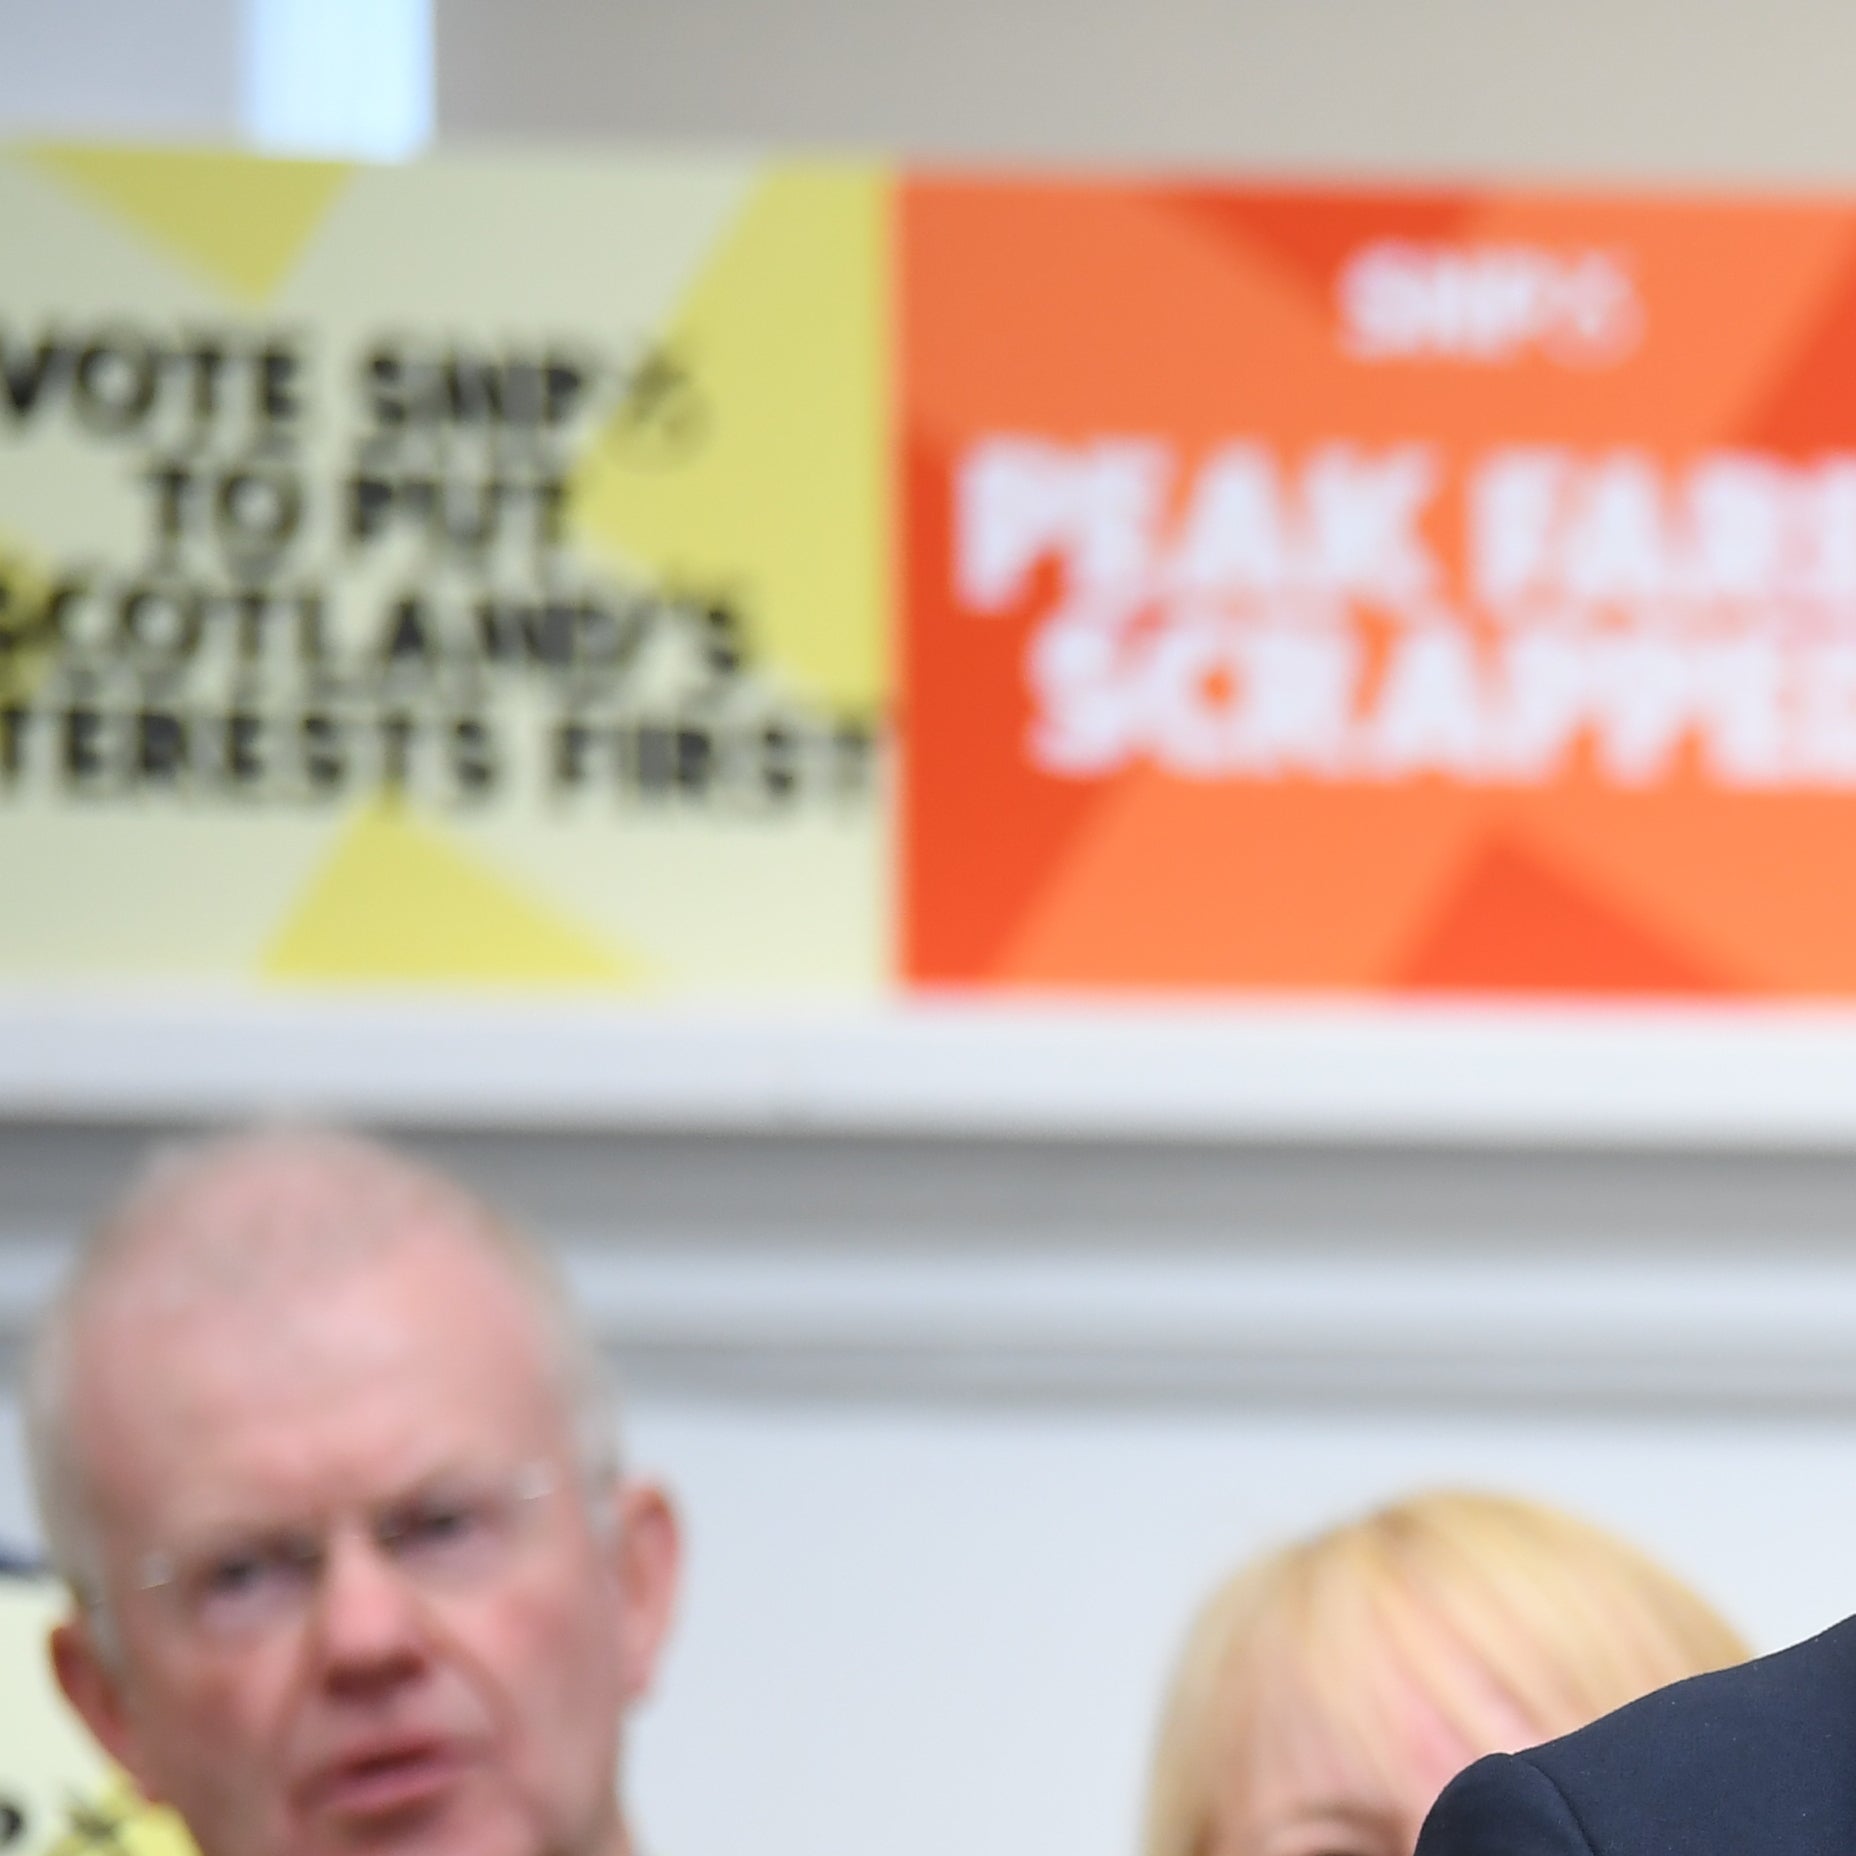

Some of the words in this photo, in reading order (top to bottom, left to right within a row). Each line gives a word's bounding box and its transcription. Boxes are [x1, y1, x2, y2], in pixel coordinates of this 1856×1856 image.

[0, 334, 298, 436] VOTE
[360, 340, 592, 440] SNP
[144, 462, 304, 560] TO
[346, 470, 574, 566] PUT
[956, 440, 1438, 608] PEAK
[548, 712, 884, 816] FIRST
